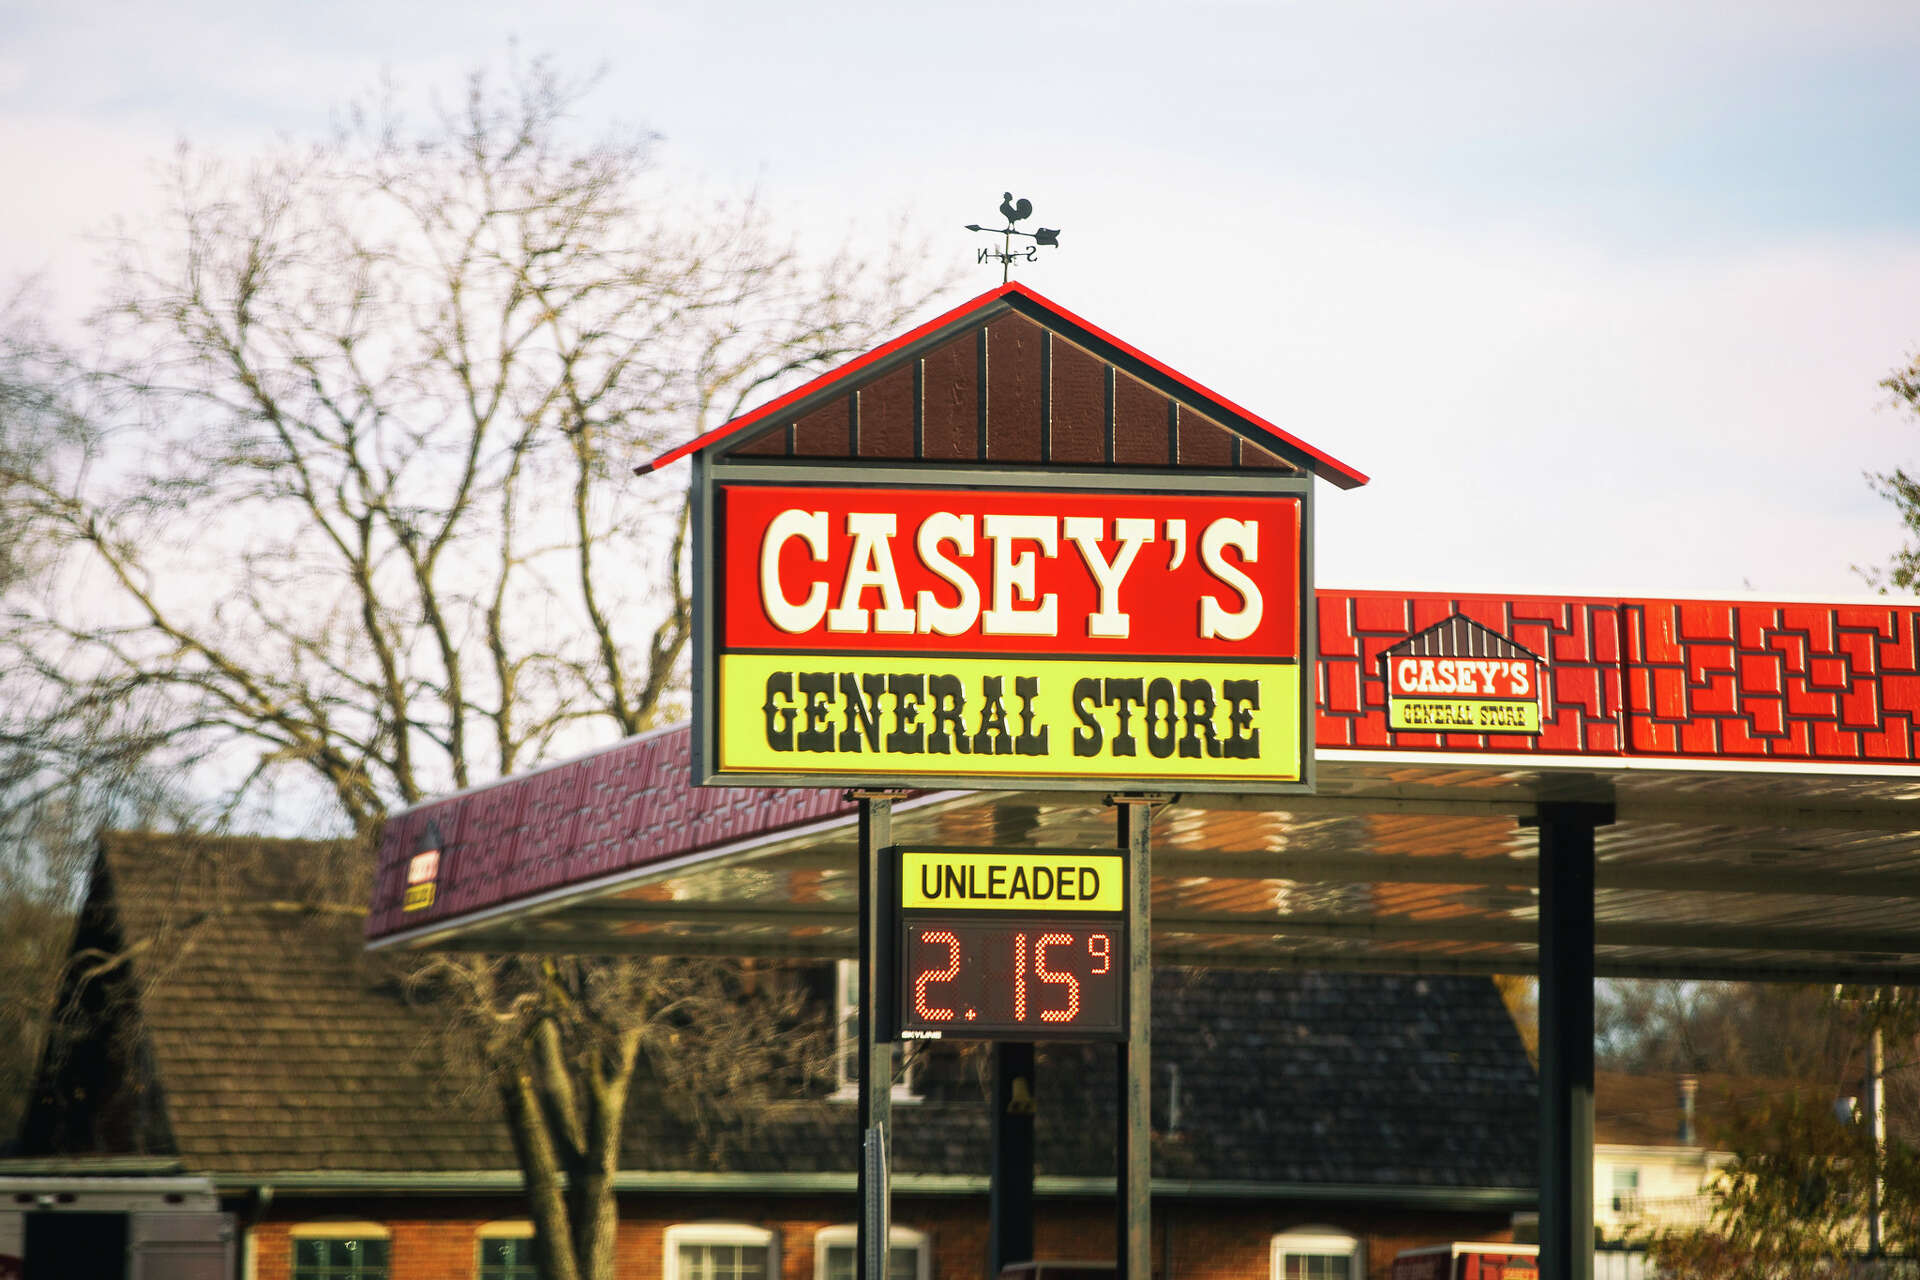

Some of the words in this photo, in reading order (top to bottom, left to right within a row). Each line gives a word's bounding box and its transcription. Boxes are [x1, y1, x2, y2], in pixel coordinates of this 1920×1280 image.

[761, 508, 1265, 641] CASEY'S
[1398, 659, 1530, 695] CASEY'S
[763, 671, 1049, 757] GENERAL
[1073, 677, 1261, 760] STORE
[1404, 703, 1474, 725] GENERAL
[1480, 705, 1526, 727] STORE
[921, 864, 1100, 901] UNLEADED
